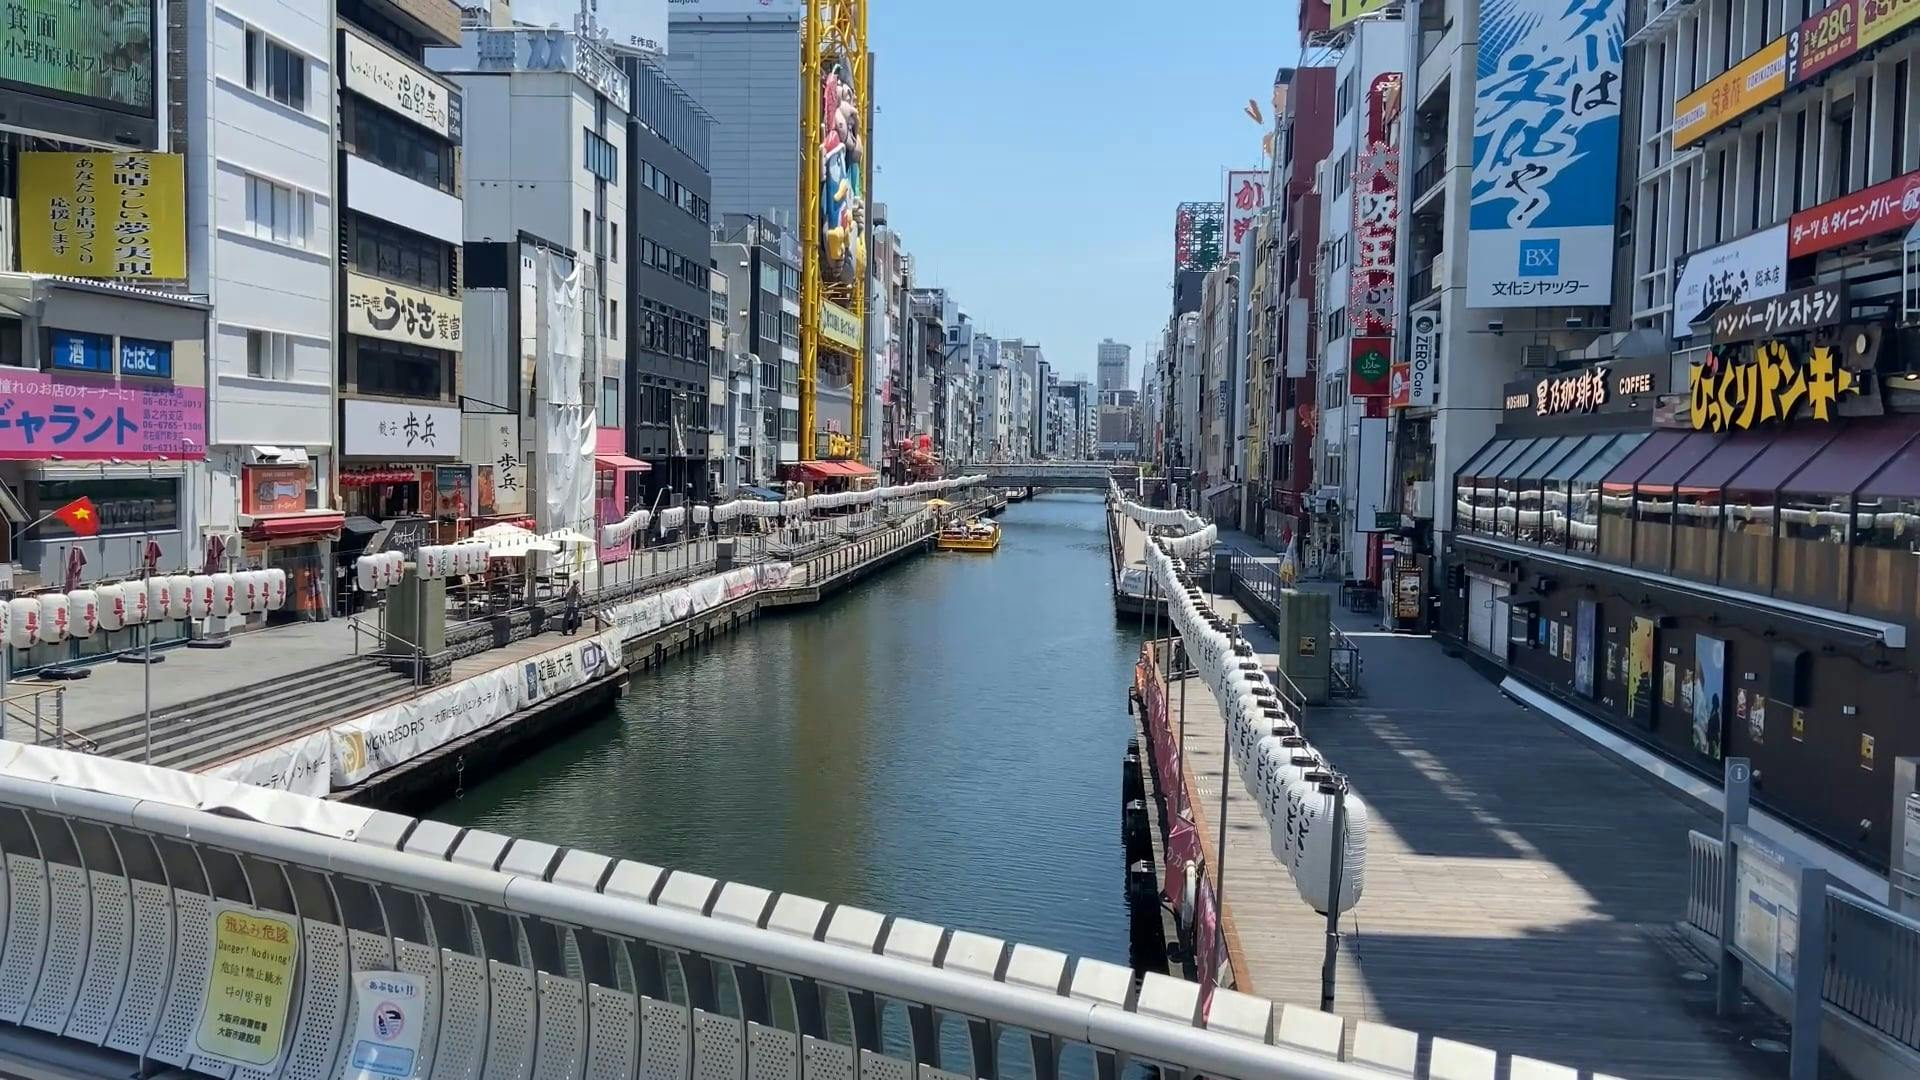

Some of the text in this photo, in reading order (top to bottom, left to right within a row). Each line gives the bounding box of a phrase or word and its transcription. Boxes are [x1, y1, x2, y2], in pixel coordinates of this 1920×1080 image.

[50, 197, 70, 255] 応援します
[75, 158, 95, 263] あなたのお店づくり
[113, 156, 152, 275] 素晴らしい夢の実現
[1525, 249, 1556, 267] BX
[1716, 290, 1839, 338] ハンバーグレストラン
[68, 339, 85, 366] 酒
[122, 345, 157, 371] たばこ
[1619, 373, 1651, 396] COFFEE
[1690, 340, 1860, 433] びっくりドンキー
[403, 411, 436, 449] 歩兵
[497, 452, 518, 492] 歩兵
[538, 653, 573, 682] 近畿大学
[225, 916, 289, 944] 飛込み危険
